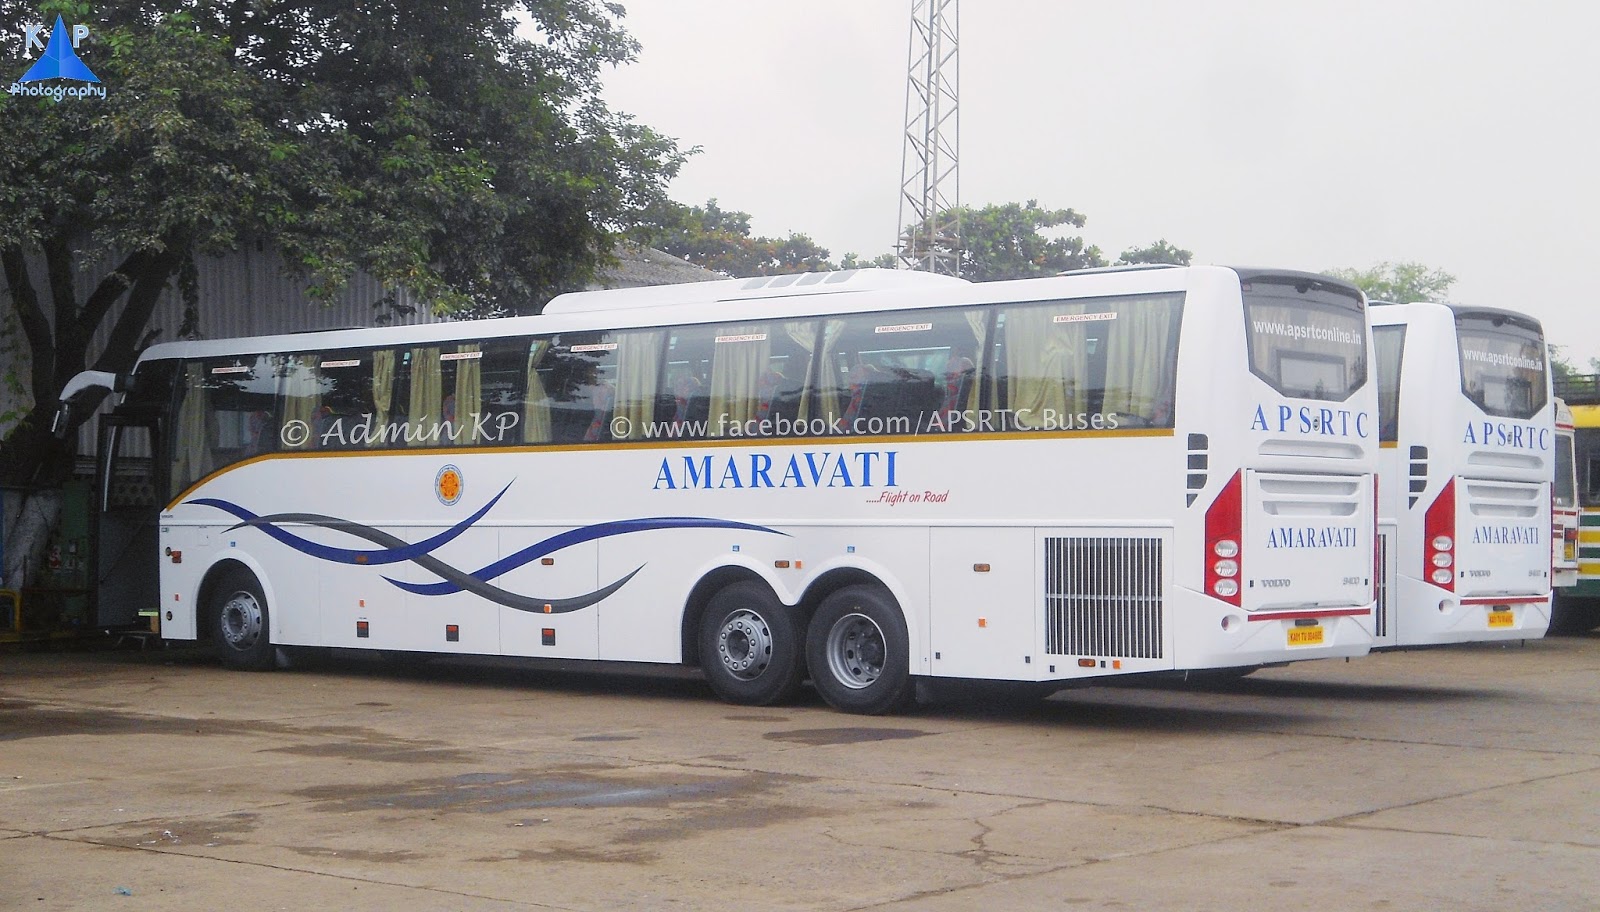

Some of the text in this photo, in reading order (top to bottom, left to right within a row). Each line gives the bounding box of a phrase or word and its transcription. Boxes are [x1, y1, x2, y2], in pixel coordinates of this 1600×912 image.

[1253, 320, 1361, 345] www.apsrtconline.in
[1463, 349, 1543, 371] www.apsrtconline.in
[653, 451, 899, 490] AMARAVATI
[909, 494, 921, 503] on
[923, 490, 950, 503] Road
[1267, 527, 1356, 548] AMARAVATI
[1472, 526, 1539, 544] AMARAVATI
[1260, 579, 1291, 588] VOLVO
